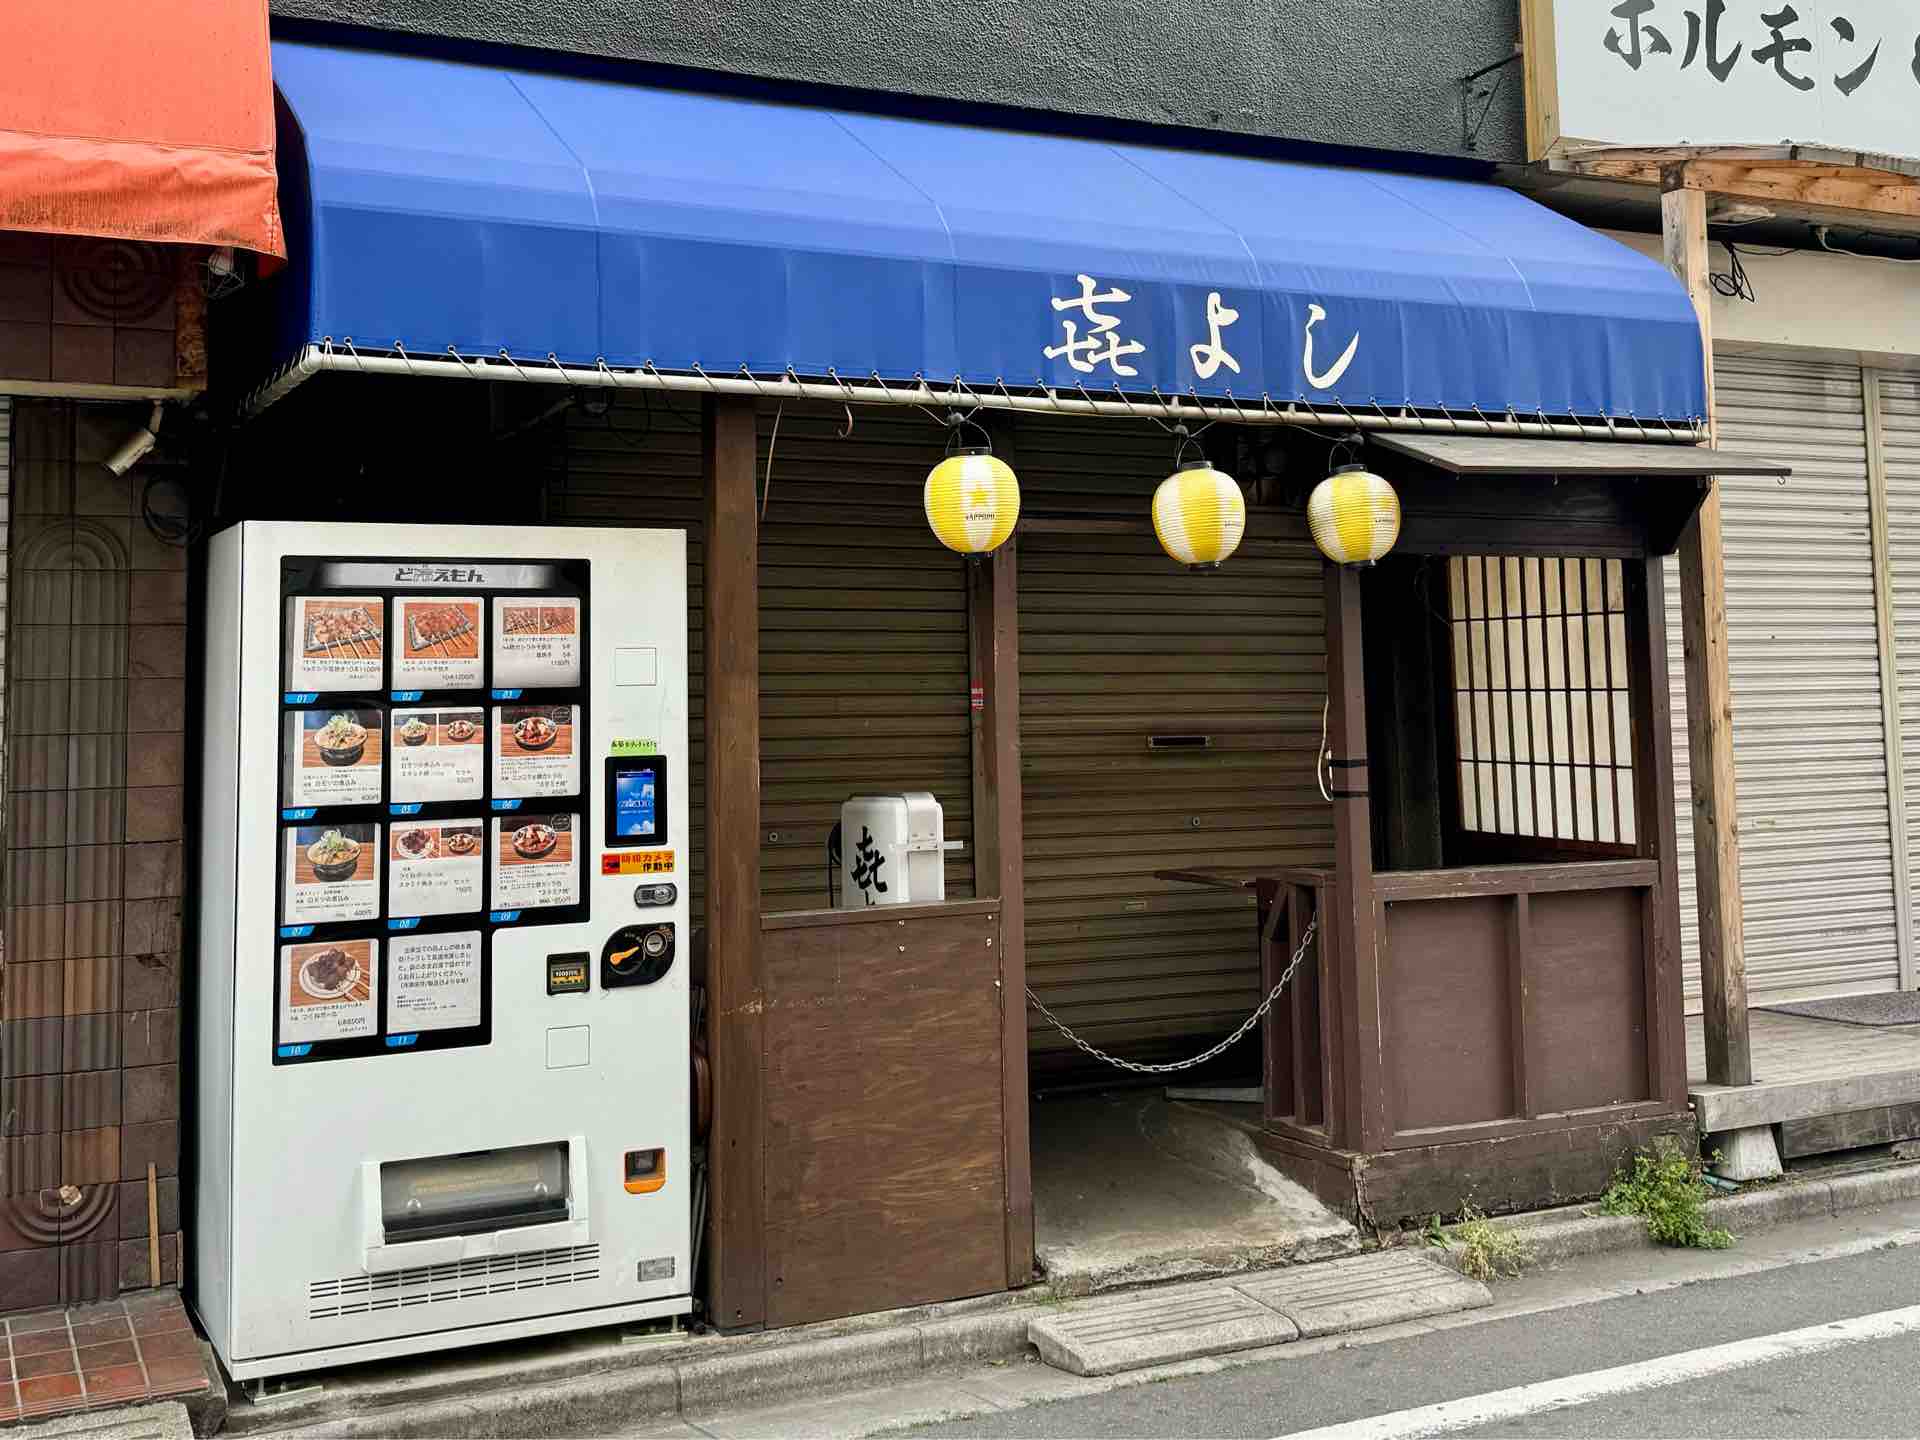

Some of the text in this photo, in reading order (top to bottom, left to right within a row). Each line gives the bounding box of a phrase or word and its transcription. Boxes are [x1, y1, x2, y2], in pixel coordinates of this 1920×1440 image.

[296, 694, 308, 704] 01
[402, 692, 413, 701] 02
[289, 1046, 302, 1055] 10
